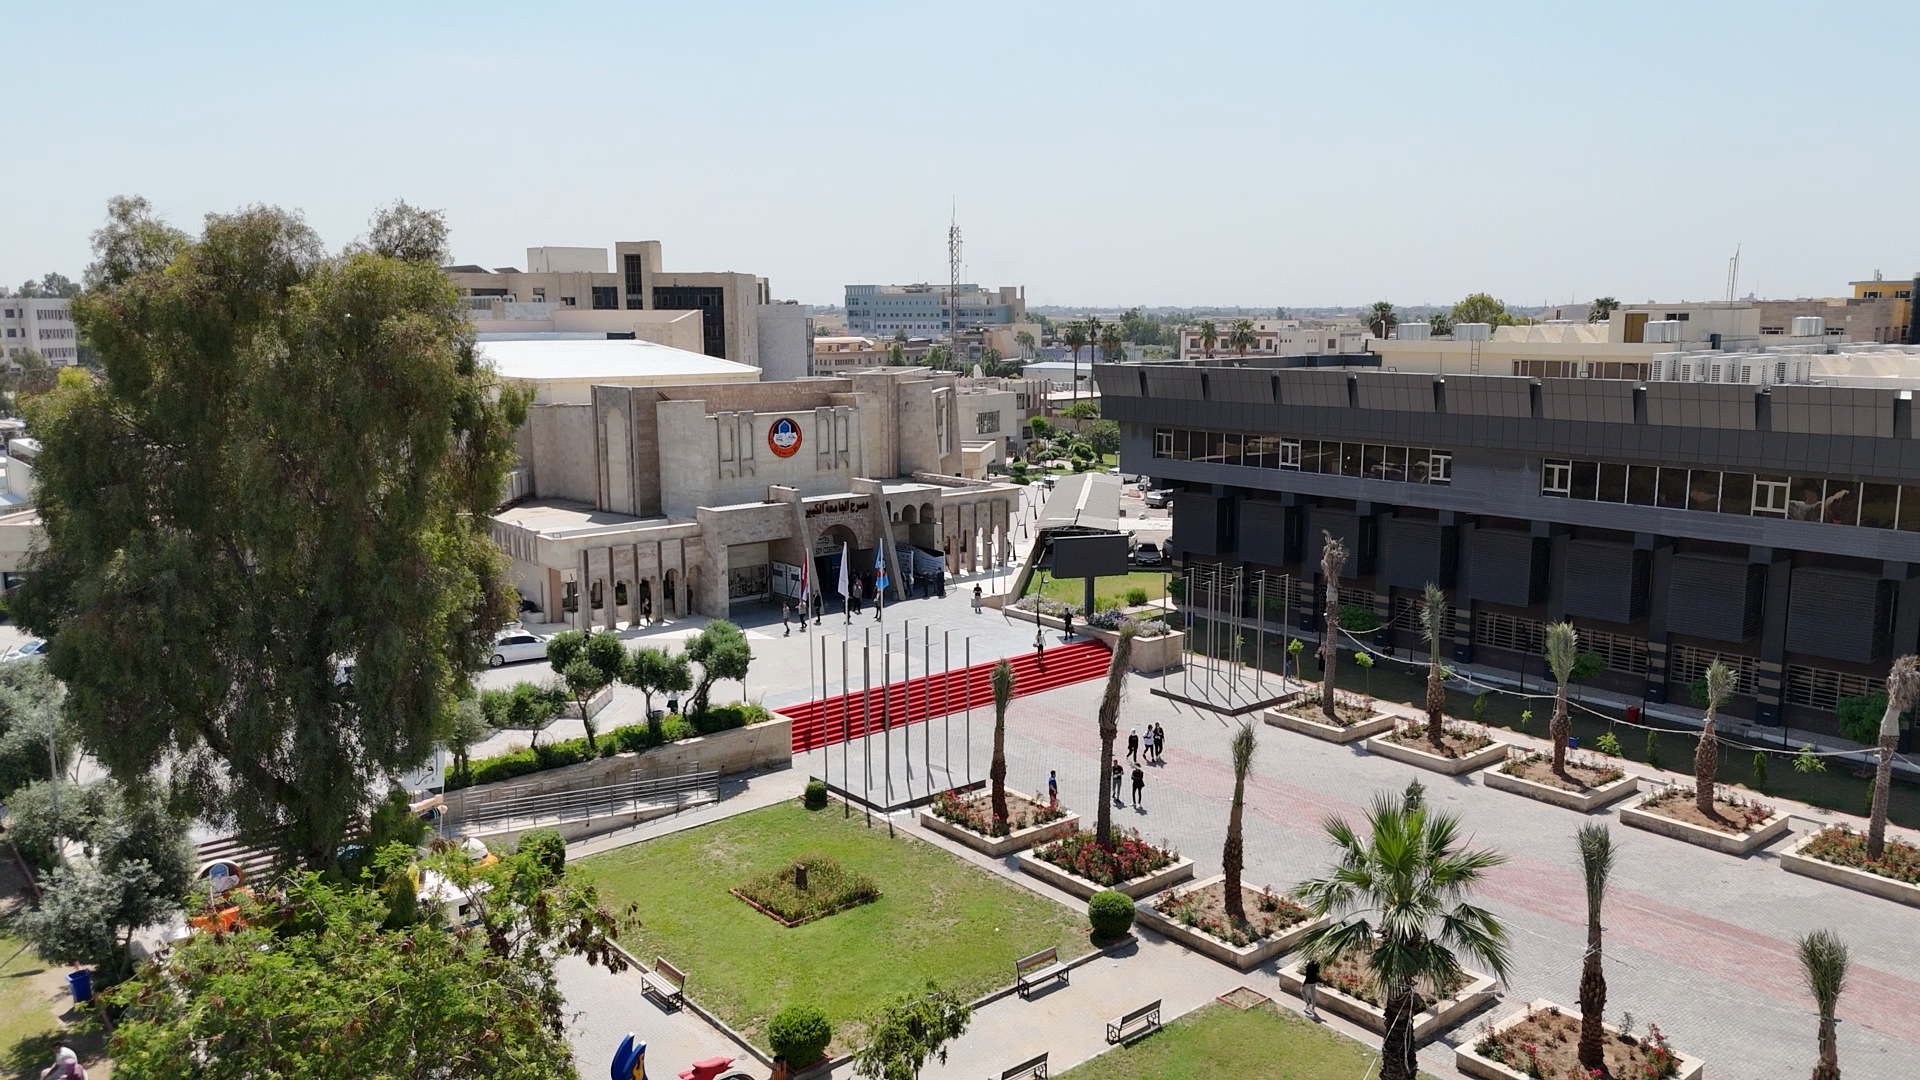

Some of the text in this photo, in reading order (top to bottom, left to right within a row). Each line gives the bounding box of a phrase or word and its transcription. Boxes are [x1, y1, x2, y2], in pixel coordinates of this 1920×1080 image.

[805, 500, 870, 519] مسرح الجامعة الكبير
